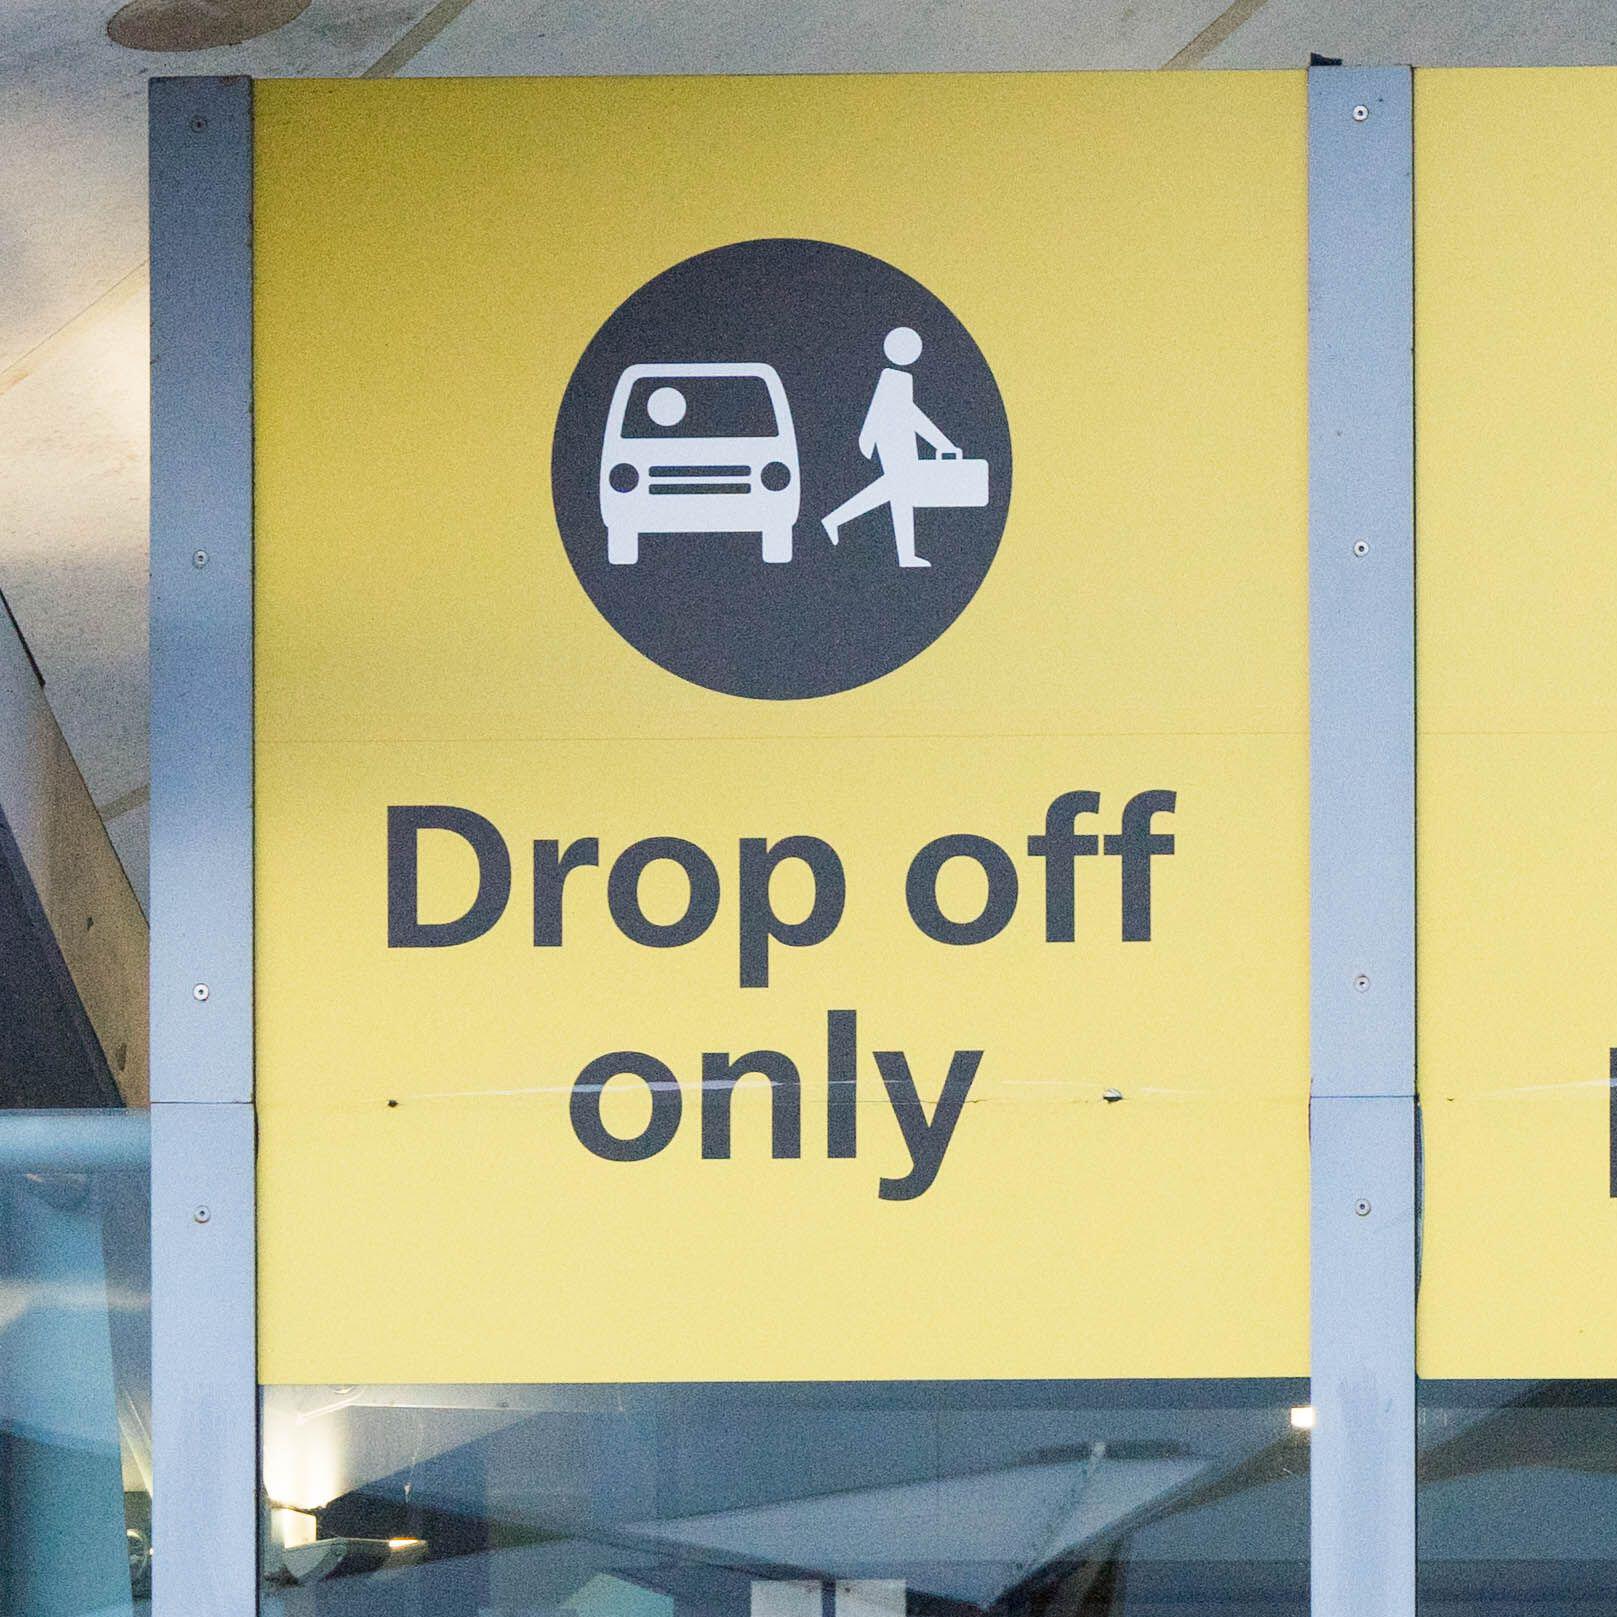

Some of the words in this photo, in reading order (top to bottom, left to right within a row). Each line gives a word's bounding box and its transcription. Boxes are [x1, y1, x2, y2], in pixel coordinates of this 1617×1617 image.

[386, 801, 845, 990] Drop
[905, 789, 1176, 946] off
[569, 1009, 983, 1201] only
